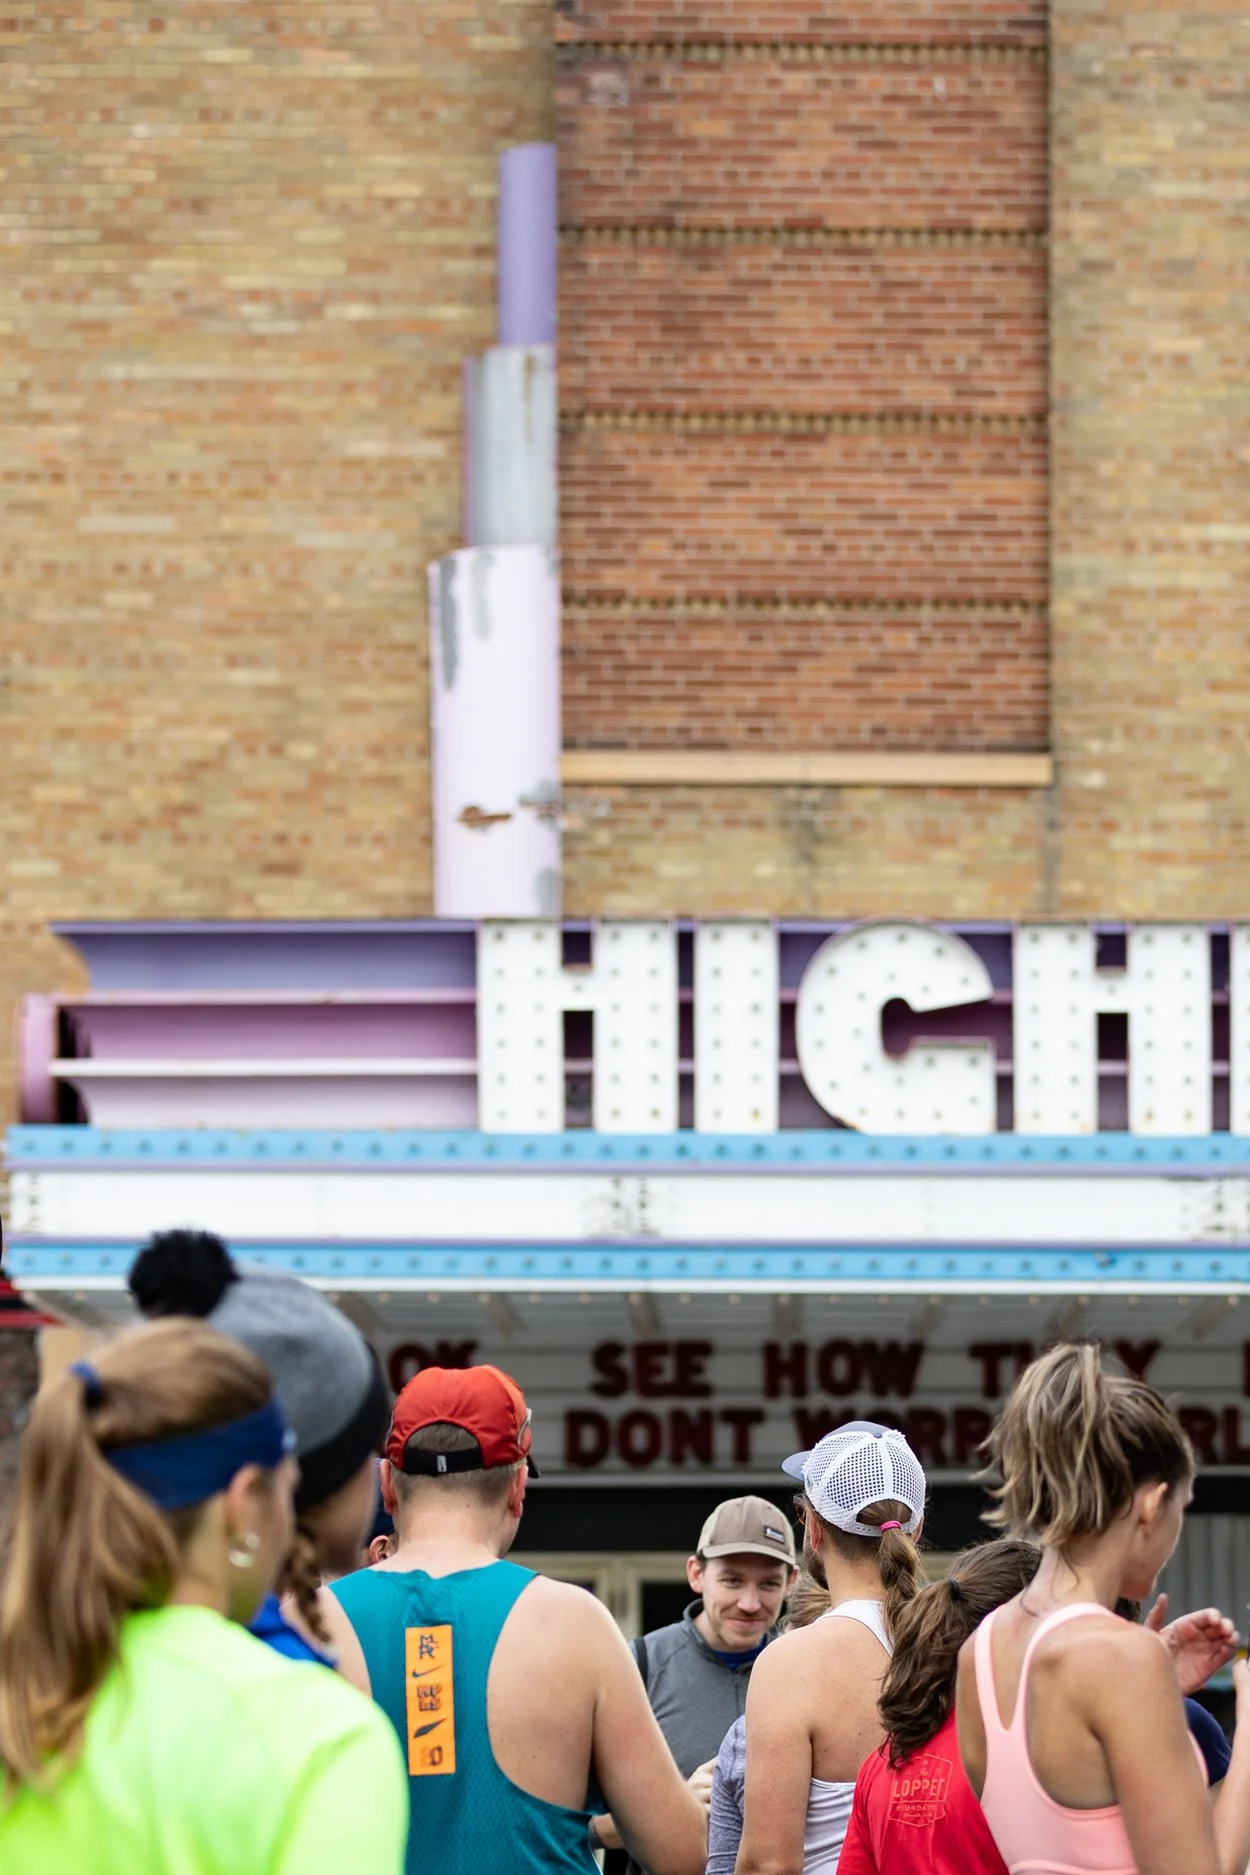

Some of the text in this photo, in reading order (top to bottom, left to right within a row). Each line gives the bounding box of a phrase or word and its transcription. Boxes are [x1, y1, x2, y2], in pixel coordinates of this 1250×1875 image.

[591, 1340, 713, 1399] SEE
[763, 1338, 925, 1399] HOW
[968, 1340, 1162, 1399] TY
[563, 1407, 765, 1468] DONT
[893, 1778, 946, 1799] LOPPET
